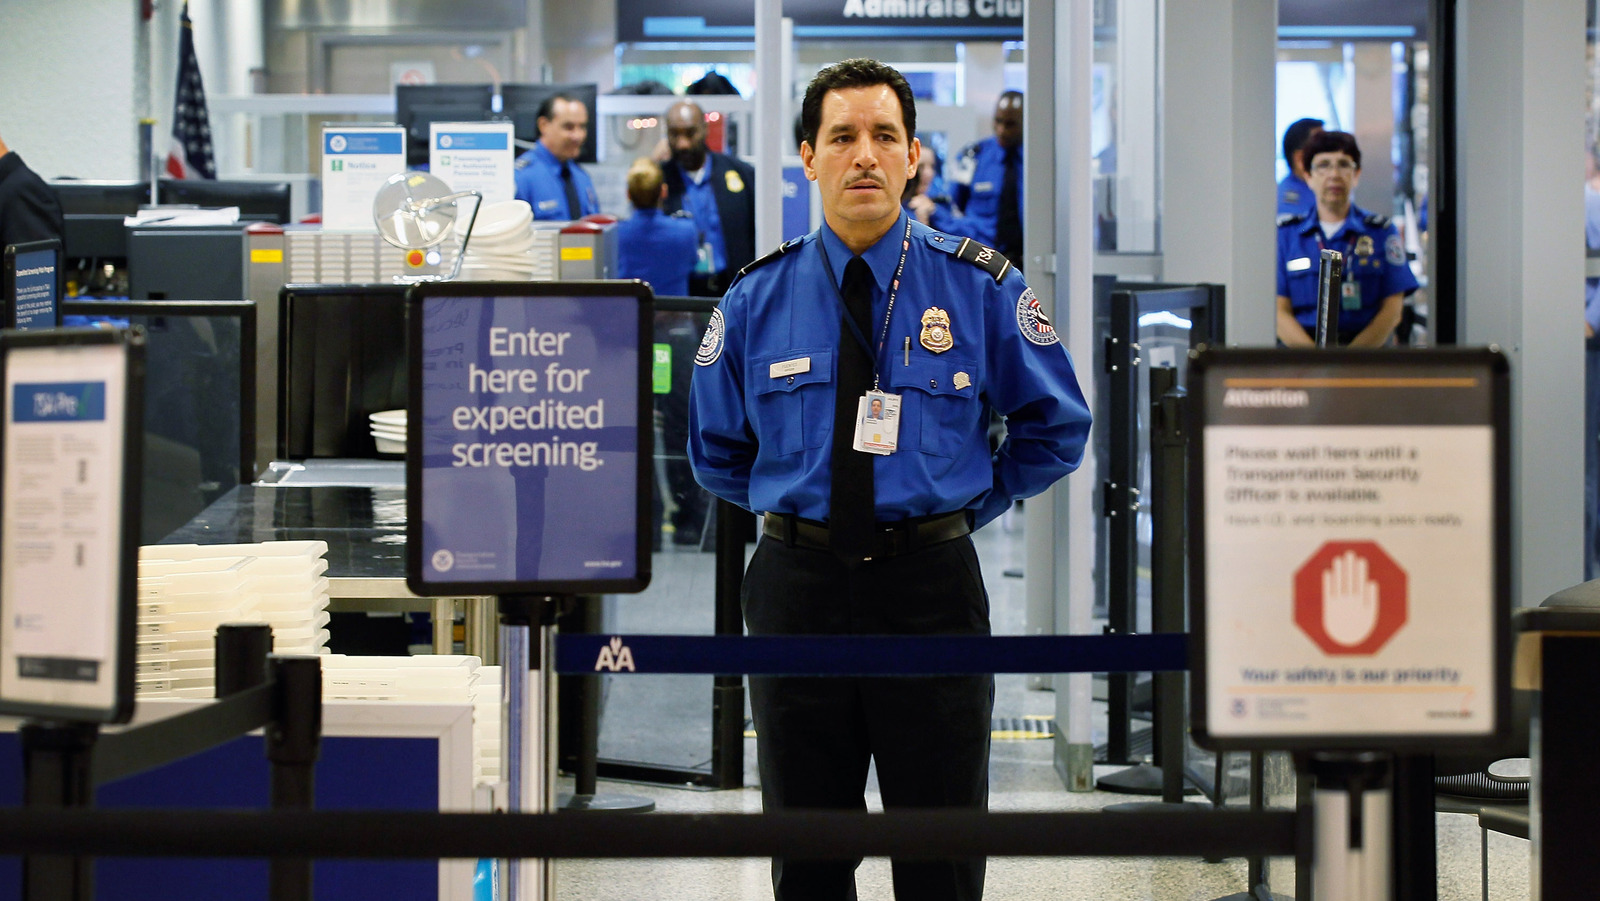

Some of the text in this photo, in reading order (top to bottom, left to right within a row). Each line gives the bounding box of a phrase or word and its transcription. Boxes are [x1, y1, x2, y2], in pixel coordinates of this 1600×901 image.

[843, 0, 970, 18] Admirals
[975, 246, 996, 265] TSA
[489, 327, 571, 356] Enter
[468, 362, 590, 393] here for
[1223, 387, 1309, 408] Attention
[452, 399, 604, 435] expedited
[452, 436, 603, 471] screening.
[1225, 446, 1278, 461] Please
[1284, 446, 1317, 461] wait
[1324, 446, 1361, 461] here
[1366, 446, 1402, 461] until
[1226, 466, 1421, 485] Transportation Security
[1225, 487, 1281, 502] Officer
[1240, 667, 1462, 685] Your safety is our priority
